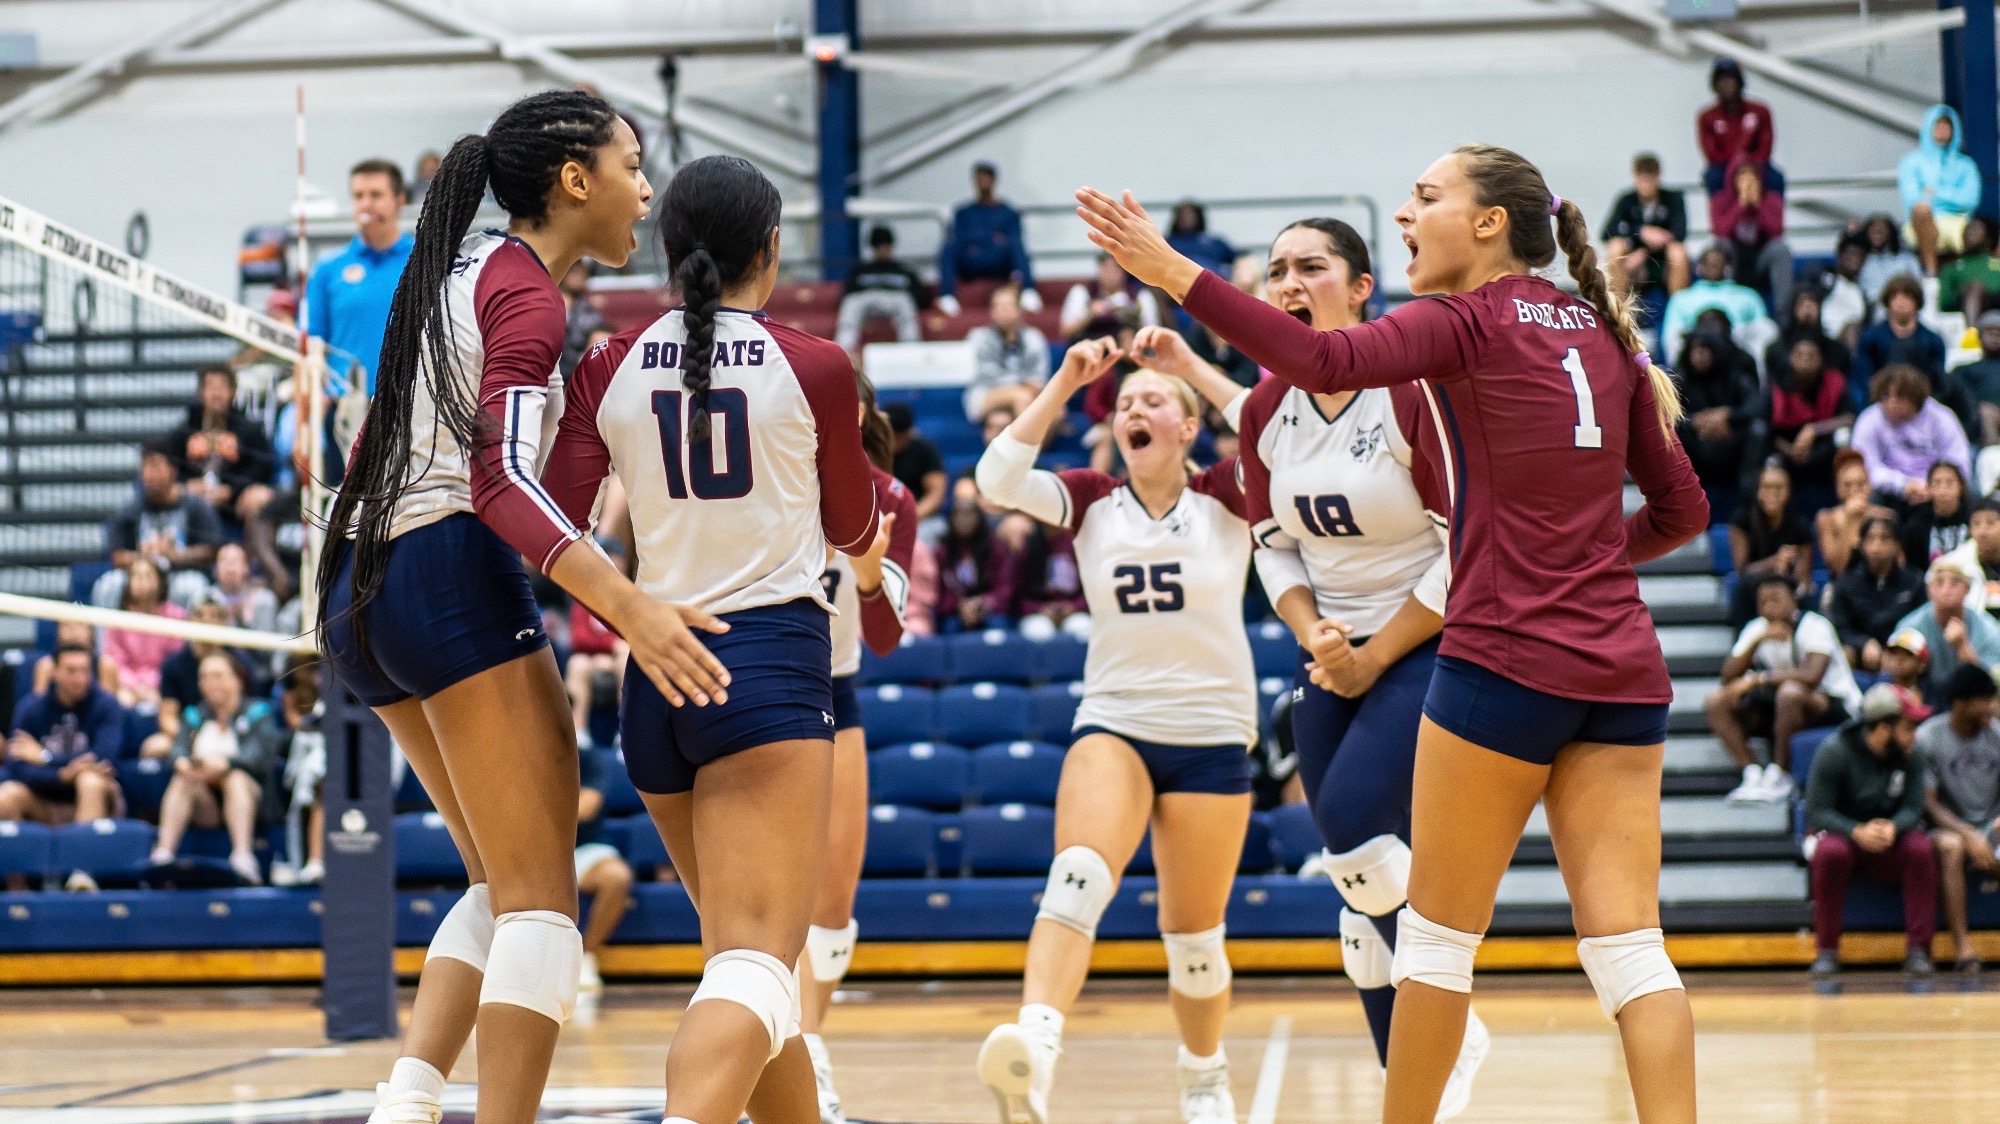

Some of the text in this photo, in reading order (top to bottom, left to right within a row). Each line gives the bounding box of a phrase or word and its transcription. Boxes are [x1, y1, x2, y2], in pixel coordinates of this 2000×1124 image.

[1512, 298, 1597, 330] BOBCATS
[641, 340, 766, 369] BOATS
[1561, 347, 1602, 449] 1
[651, 387, 754, 500] 10
[1294, 494, 1365, 537] 18
[1113, 562, 1184, 613] 25
